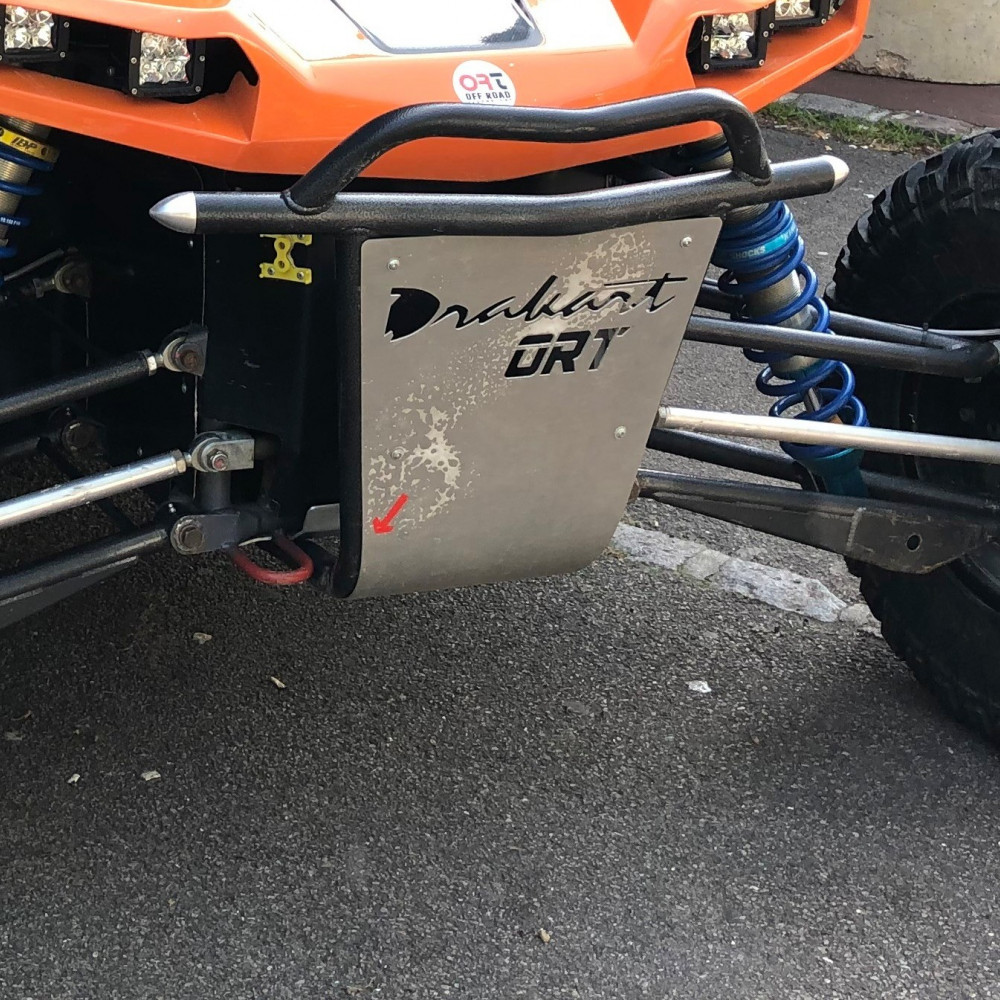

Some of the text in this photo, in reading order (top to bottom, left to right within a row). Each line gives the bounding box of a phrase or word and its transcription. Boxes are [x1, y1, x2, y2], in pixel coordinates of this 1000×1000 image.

[465, 92, 482, 101] OFF
[485, 90, 511, 100] ROAD
[384, 273, 689, 342] Drakart
[504, 326, 630, 379] ORT
